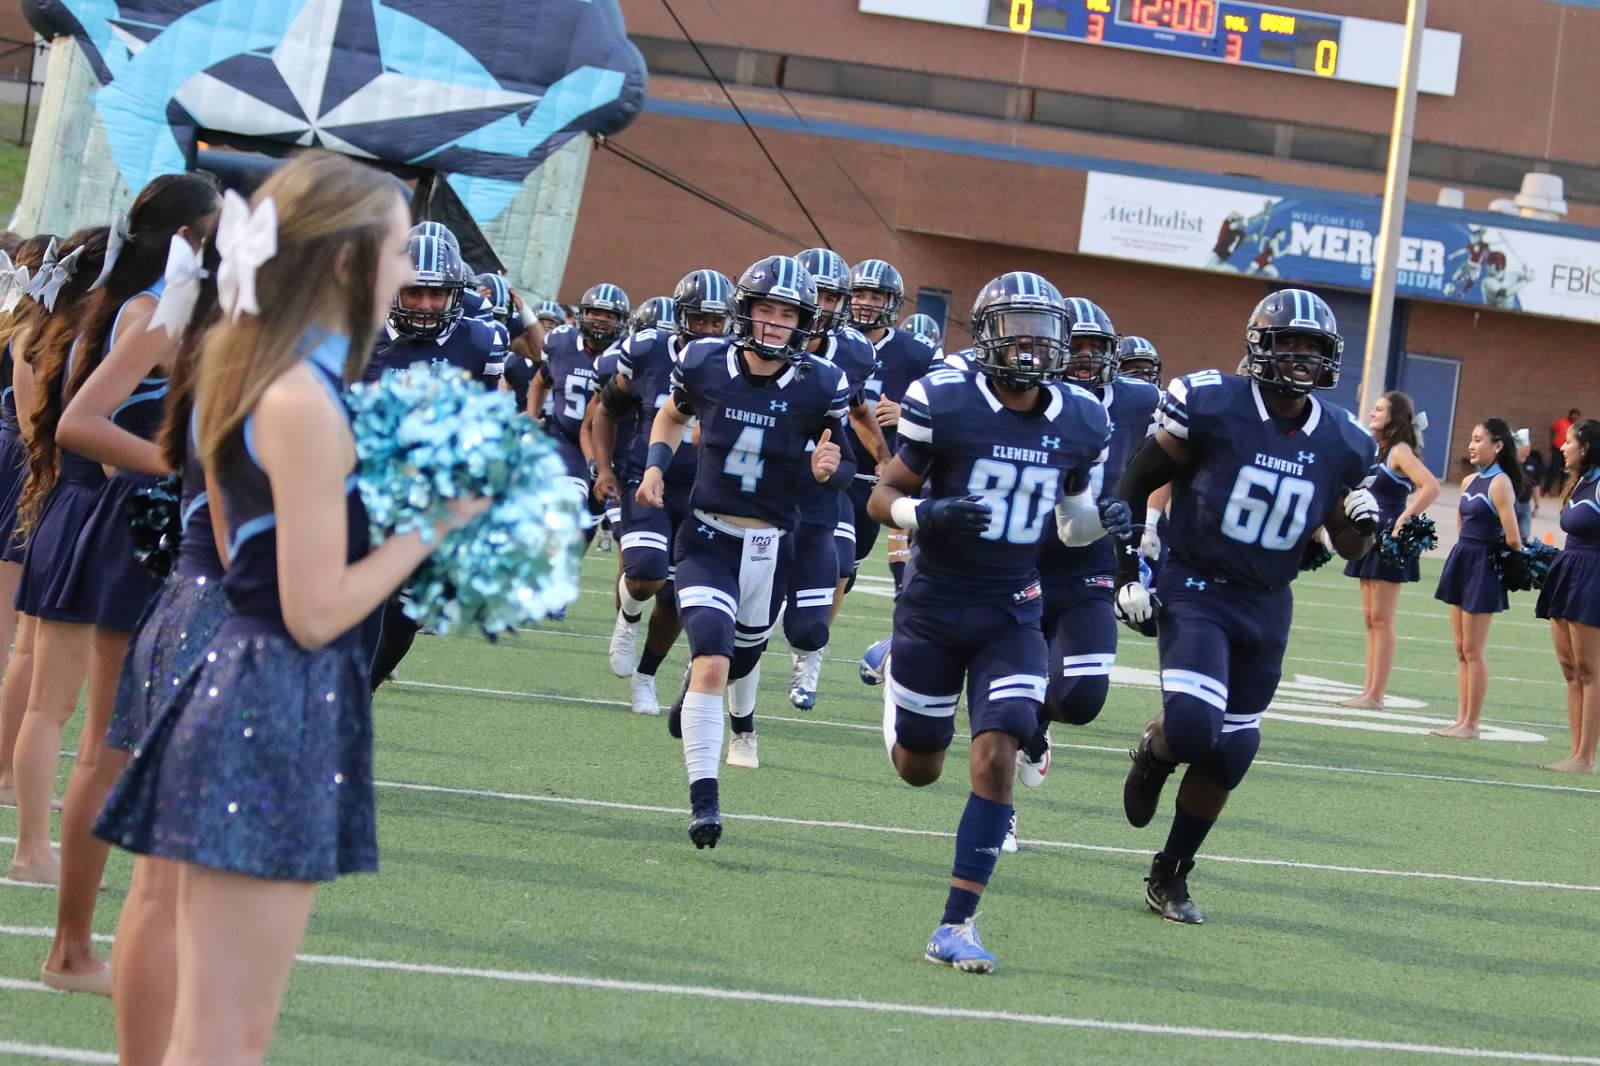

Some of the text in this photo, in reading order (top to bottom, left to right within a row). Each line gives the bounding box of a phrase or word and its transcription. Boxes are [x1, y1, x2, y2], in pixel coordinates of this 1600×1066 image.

[1009, 0, 1033, 33] 0
[1088, 14, 1105, 42] 3
[1131, 0, 1215, 33] 12:00
[1225, 33, 1243, 63] 3
[1315, 39, 1338, 76] 0
[1101, 205, 1204, 233] Methodist
[1291, 211, 1365, 230] WELCOME TO
[1288, 221, 1446, 275] MERER
[1360, 265, 1444, 291] SDIUM
[724, 406, 777, 428] CLEMENTS
[723, 425, 766, 493] 4
[992, 444, 1049, 464] CLEMENTS
[1254, 452, 1304, 476] CLEMENTS
[967, 457, 1060, 545] 80
[1220, 465, 1316, 551] 60
